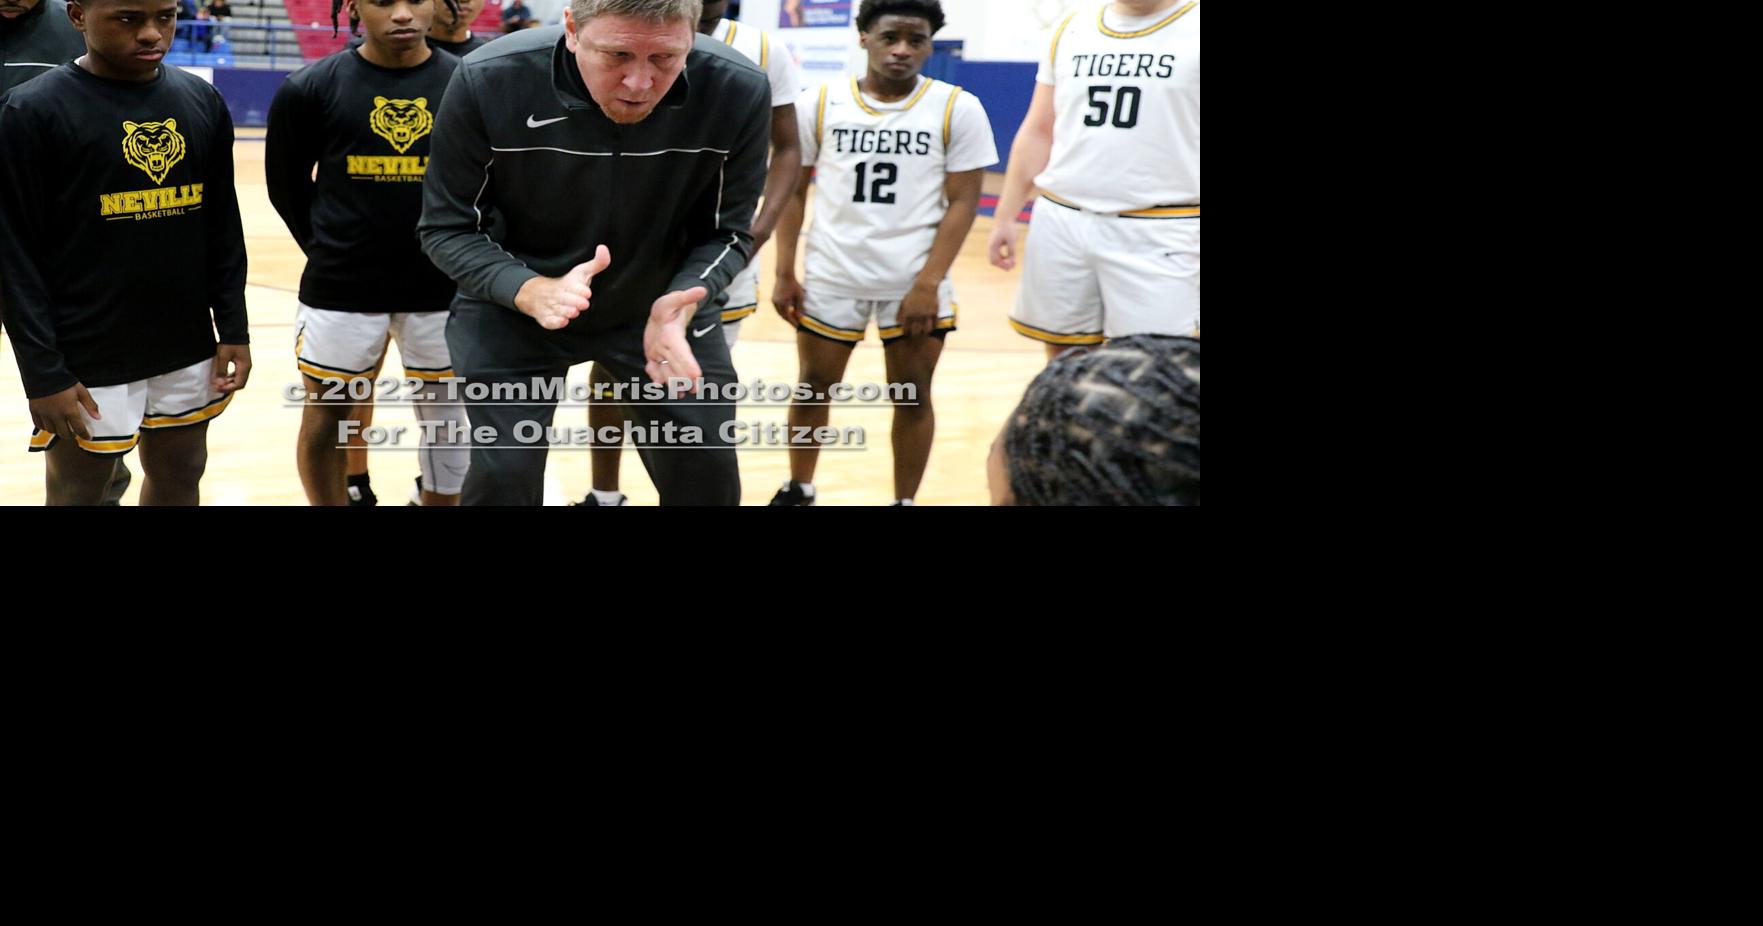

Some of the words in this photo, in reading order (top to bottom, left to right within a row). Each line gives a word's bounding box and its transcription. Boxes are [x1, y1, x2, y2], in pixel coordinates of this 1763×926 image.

[1072, 53, 1175, 79] TIGERS
[1083, 85, 1142, 129] 50
[832, 128, 931, 155] TIGERS
[852, 161, 898, 204] 12
[100, 183, 204, 216] NEVILLE
[134, 207, 185, 221] BASKETBALL
